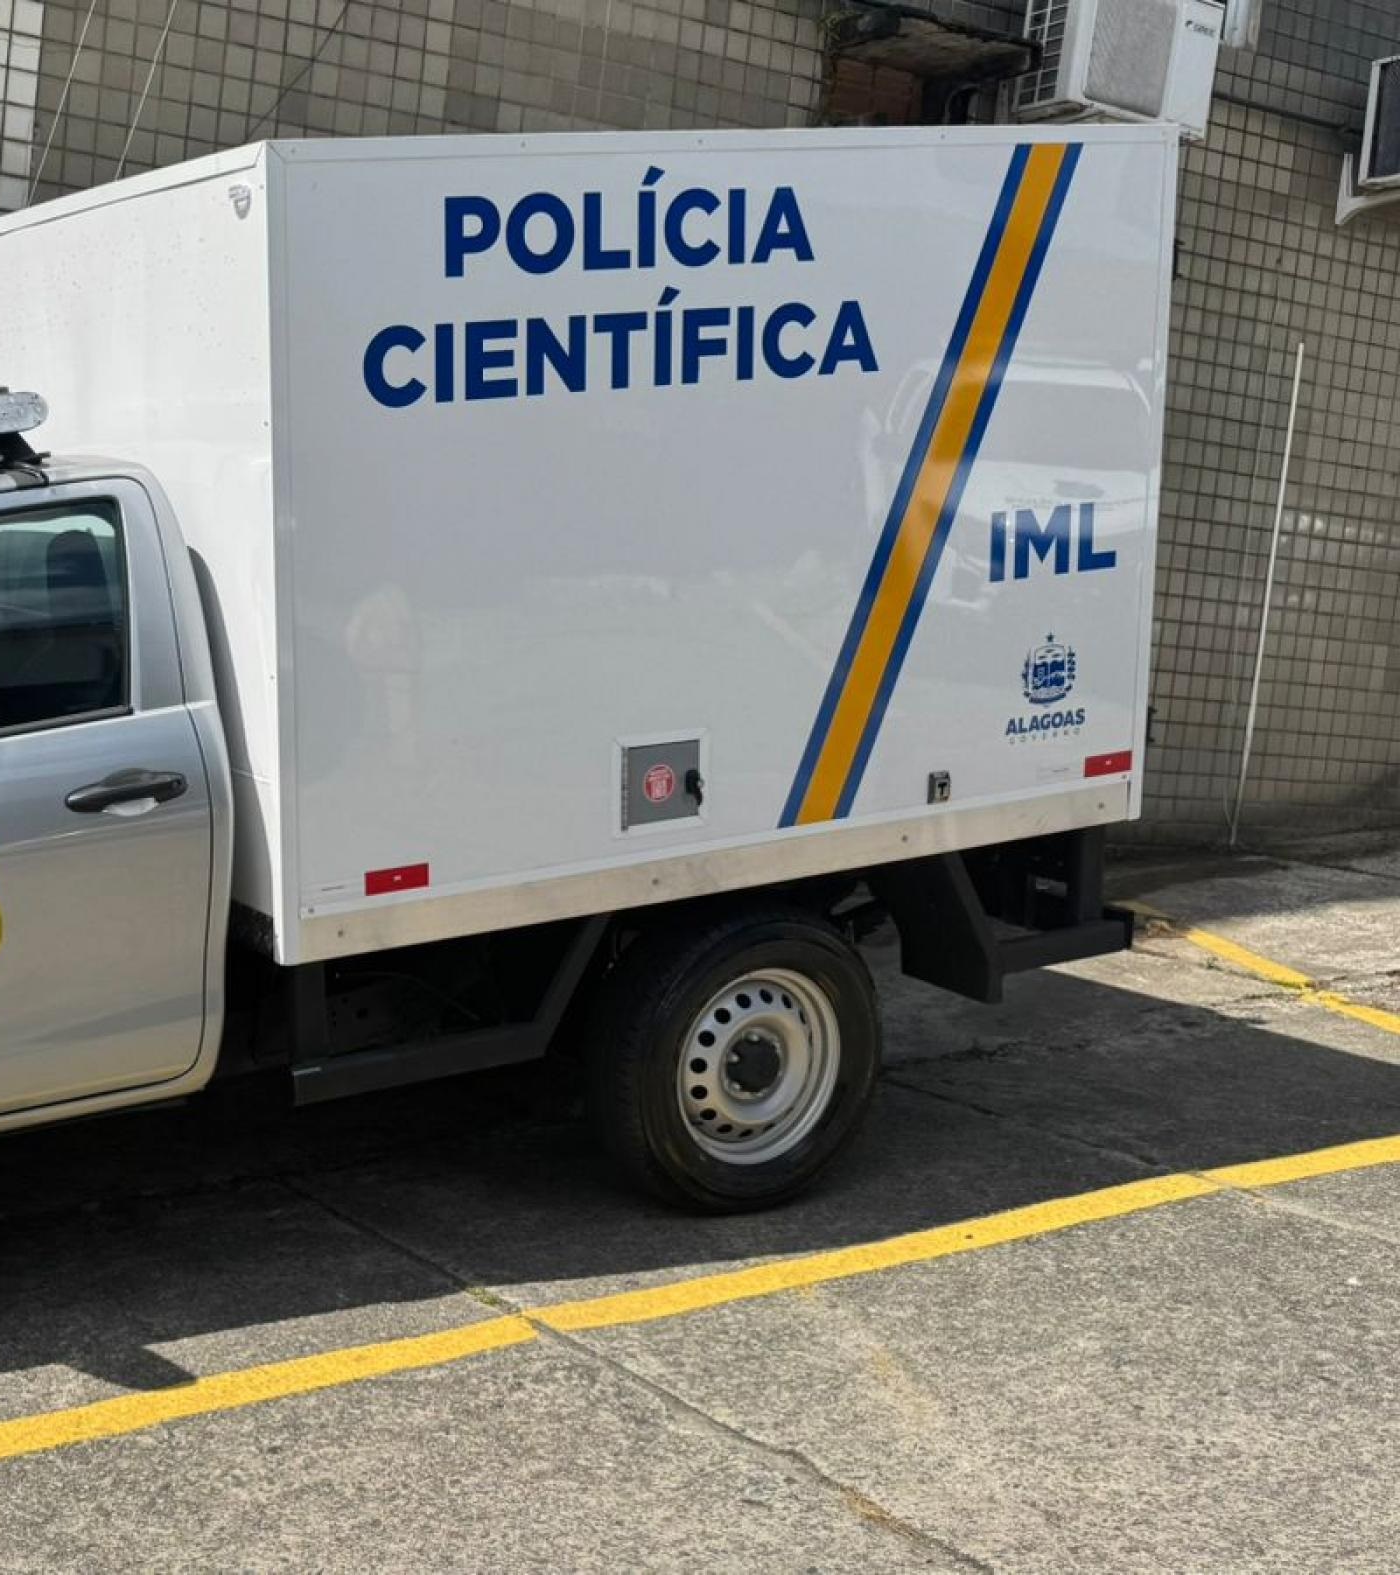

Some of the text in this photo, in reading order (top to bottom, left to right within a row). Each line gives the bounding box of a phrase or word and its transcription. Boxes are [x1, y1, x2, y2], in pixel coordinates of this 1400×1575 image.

[443, 166, 814, 280] POLÍCIA
[363, 287, 879, 409] CIENTÍFICA
[989, 502, 1117, 582] IML
[1004, 707, 1086, 736] ALAGOAS
